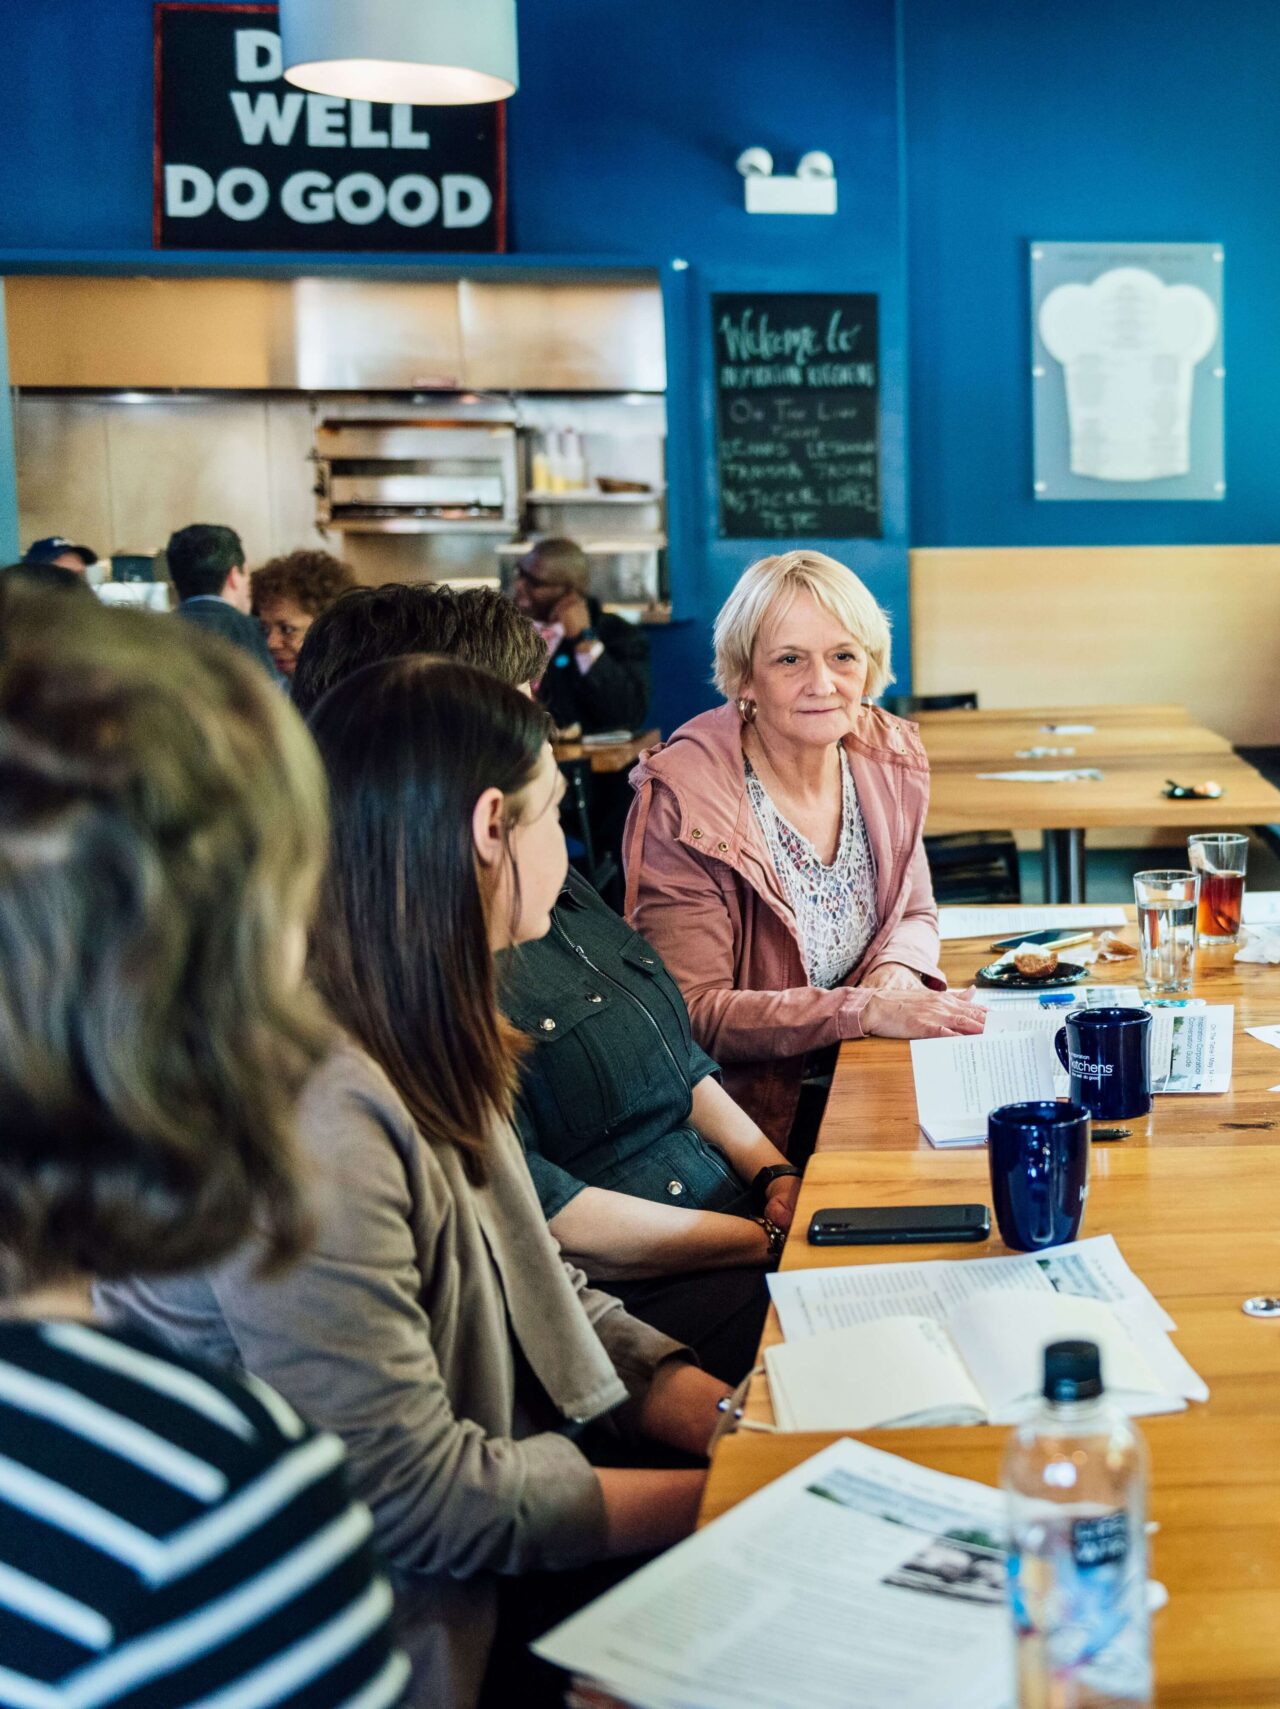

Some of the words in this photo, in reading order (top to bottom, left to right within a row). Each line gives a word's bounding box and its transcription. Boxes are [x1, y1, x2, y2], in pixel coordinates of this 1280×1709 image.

[234, 28, 283, 82] D
[229, 91, 430, 150] WELL
[164, 164, 270, 221] DO
[281, 170, 493, 228] GOOD
